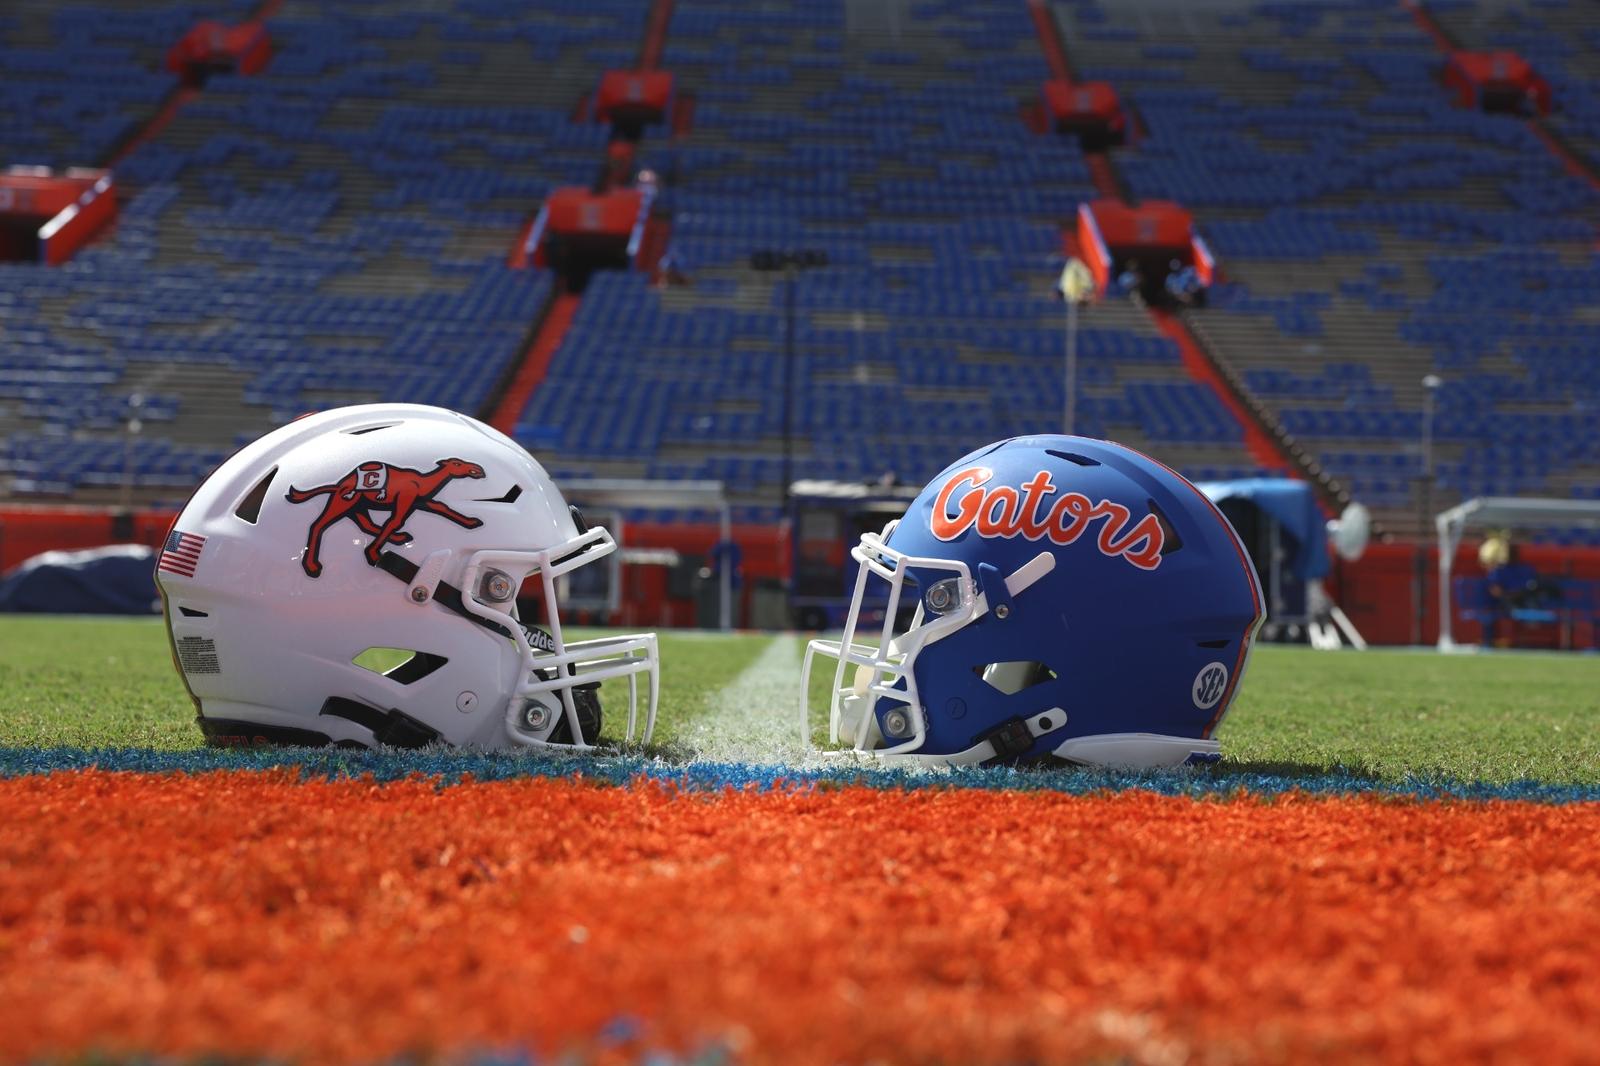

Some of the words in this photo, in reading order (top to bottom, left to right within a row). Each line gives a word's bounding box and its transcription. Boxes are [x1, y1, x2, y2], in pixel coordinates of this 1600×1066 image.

[363, 471, 380, 488] C
[930, 466, 1165, 571] Gators
[1195, 665, 1226, 706] SEC
